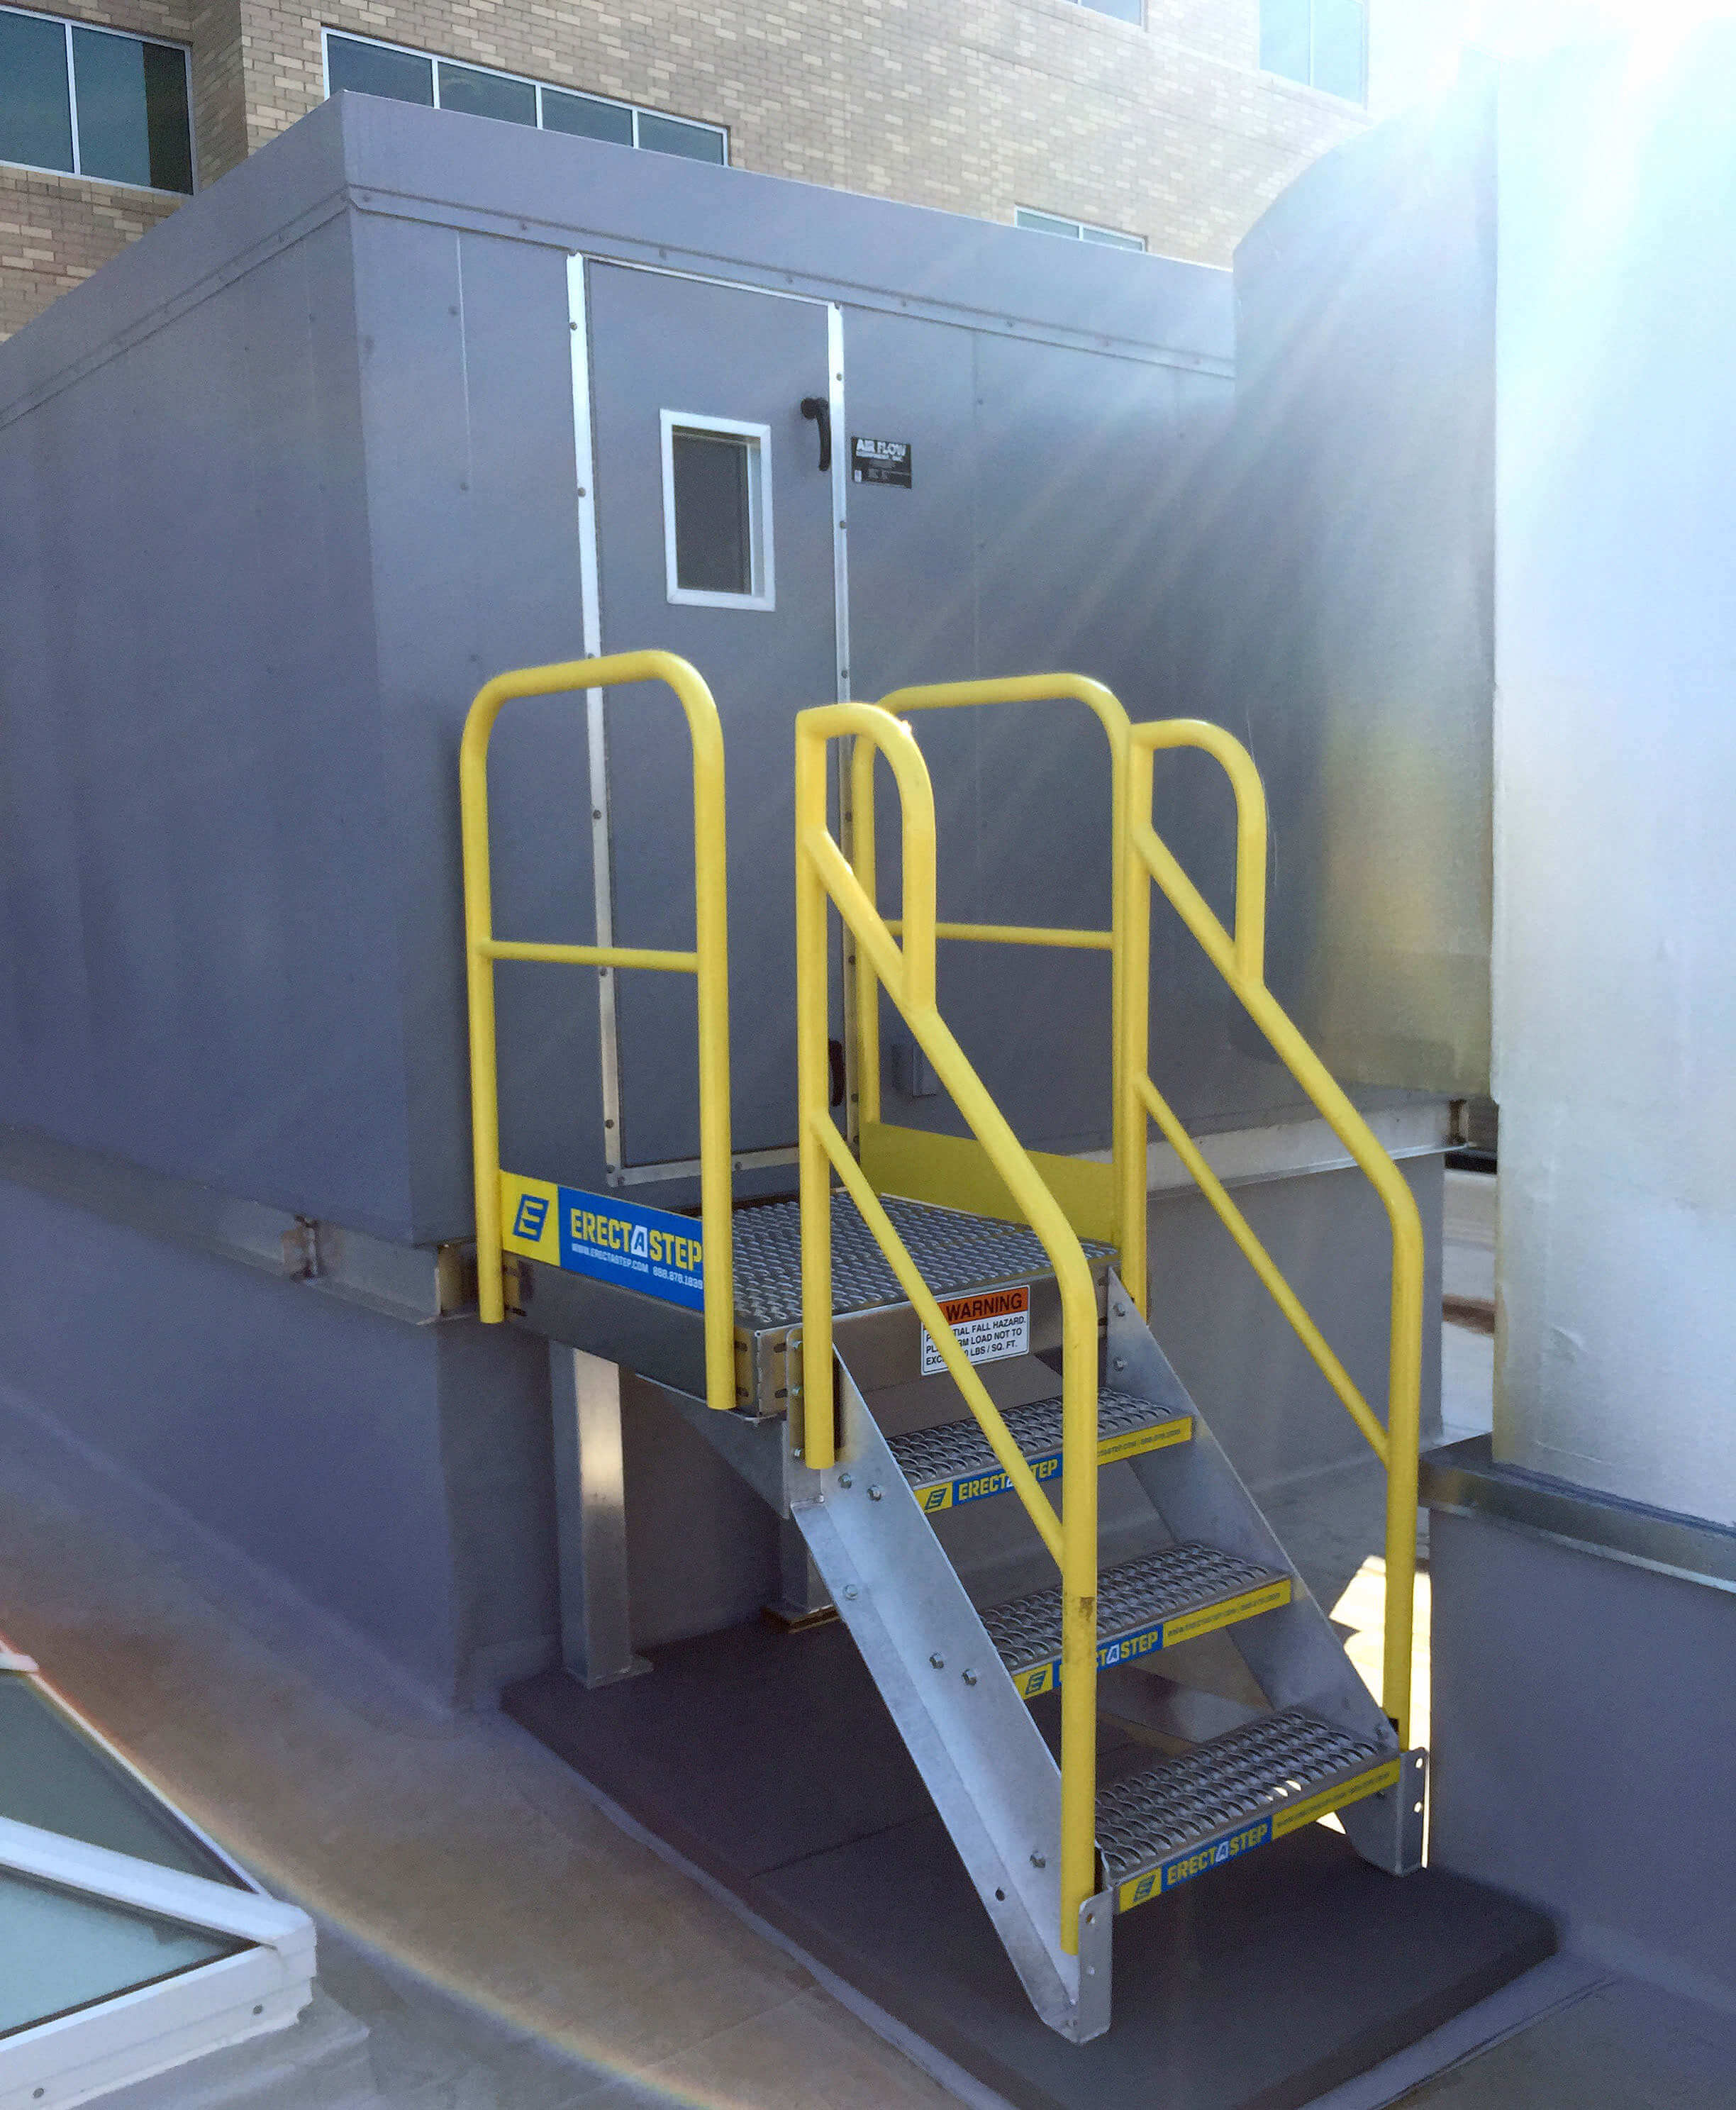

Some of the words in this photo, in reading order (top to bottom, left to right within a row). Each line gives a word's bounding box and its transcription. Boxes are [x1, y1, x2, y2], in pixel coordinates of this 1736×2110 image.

[571, 1208, 702, 1271] ERECTASTEP
[946, 1293, 1023, 1321] WARNING
[926, 1328, 970, 1343] PTIAL
[972, 1323, 991, 1333] FALL
[993, 1316, 1026, 1328] HAZARD.
[926, 1338, 969, 1354] PLRM
[971, 1335, 993, 1345] LOAD
[994, 1330, 1011, 1340] NOT
[1011, 1328, 1023, 1337] TO
[970, 1346, 986, 1357] LBS
[959, 1458, 1058, 1501] ERECTTEP
[1167, 1823, 1268, 1885] ERECTASTEP
